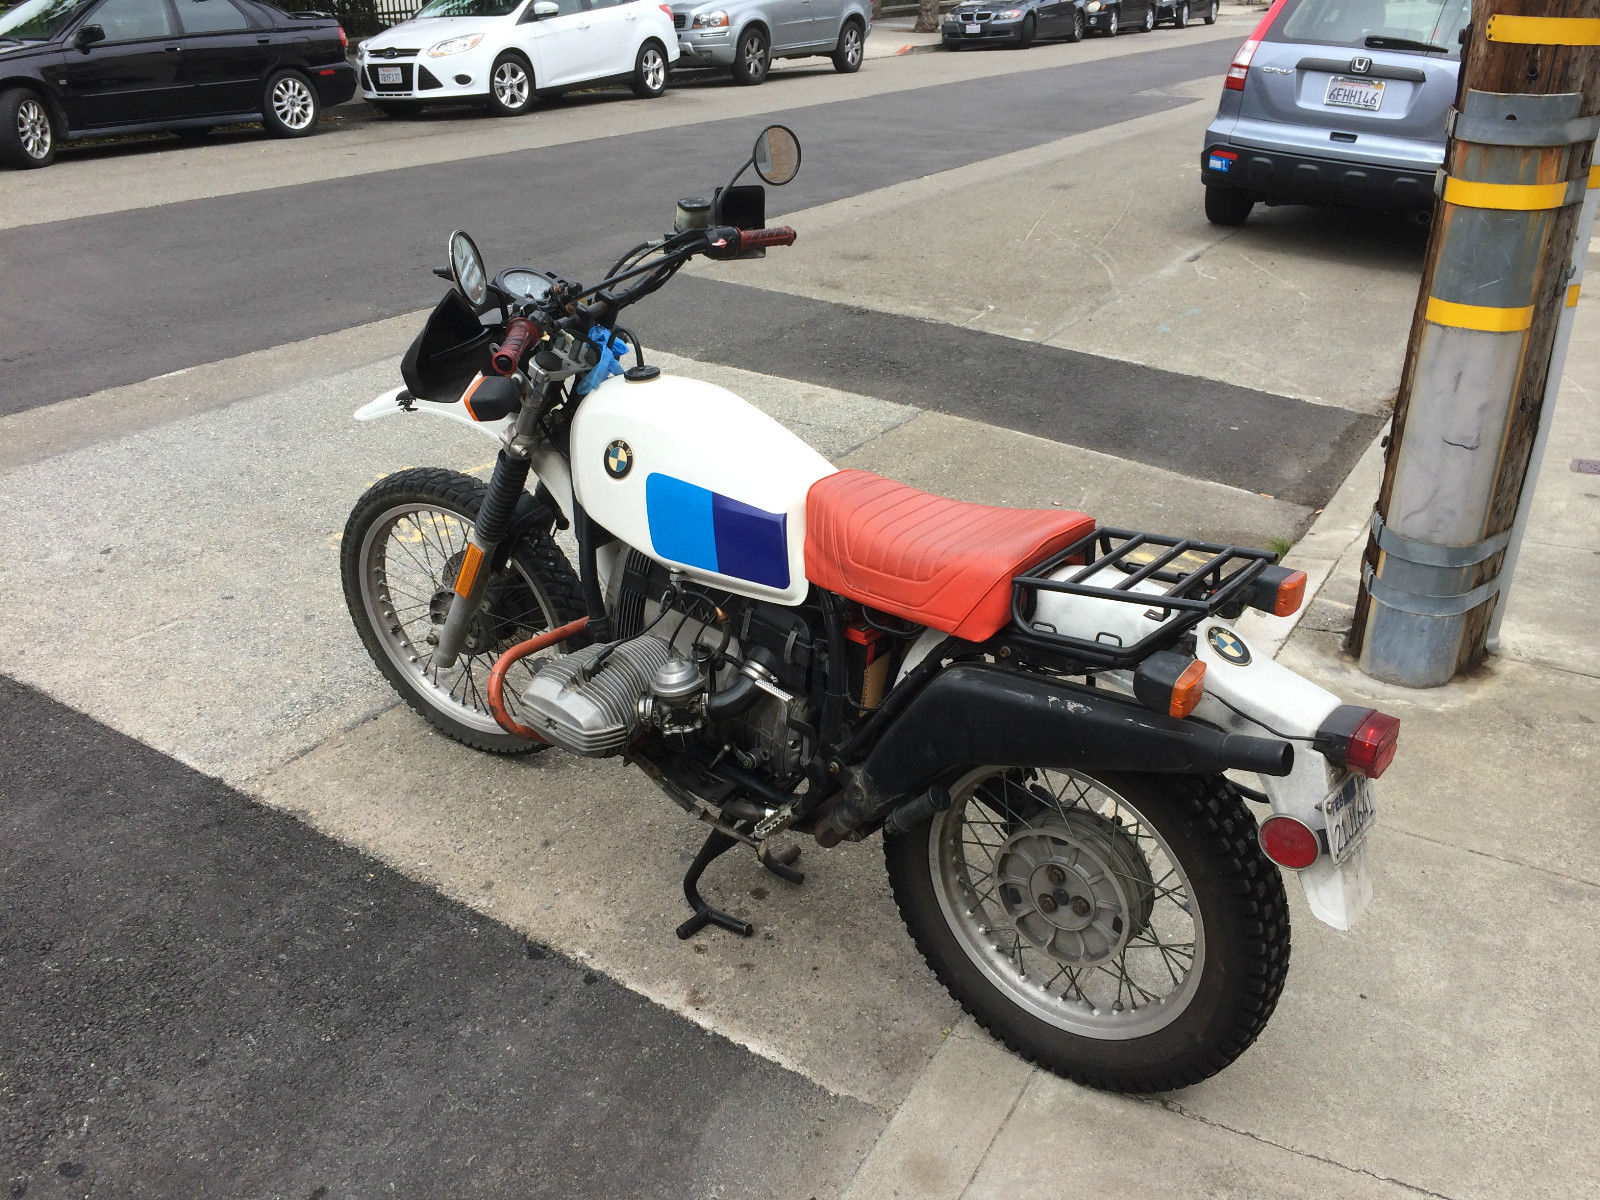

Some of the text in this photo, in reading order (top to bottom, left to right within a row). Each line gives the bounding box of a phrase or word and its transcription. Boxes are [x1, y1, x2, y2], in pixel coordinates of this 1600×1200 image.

[1328, 87, 1379, 105] 6EHH146
[608, 440, 633, 457] BMW
[1209, 628, 1231, 646] BMW
